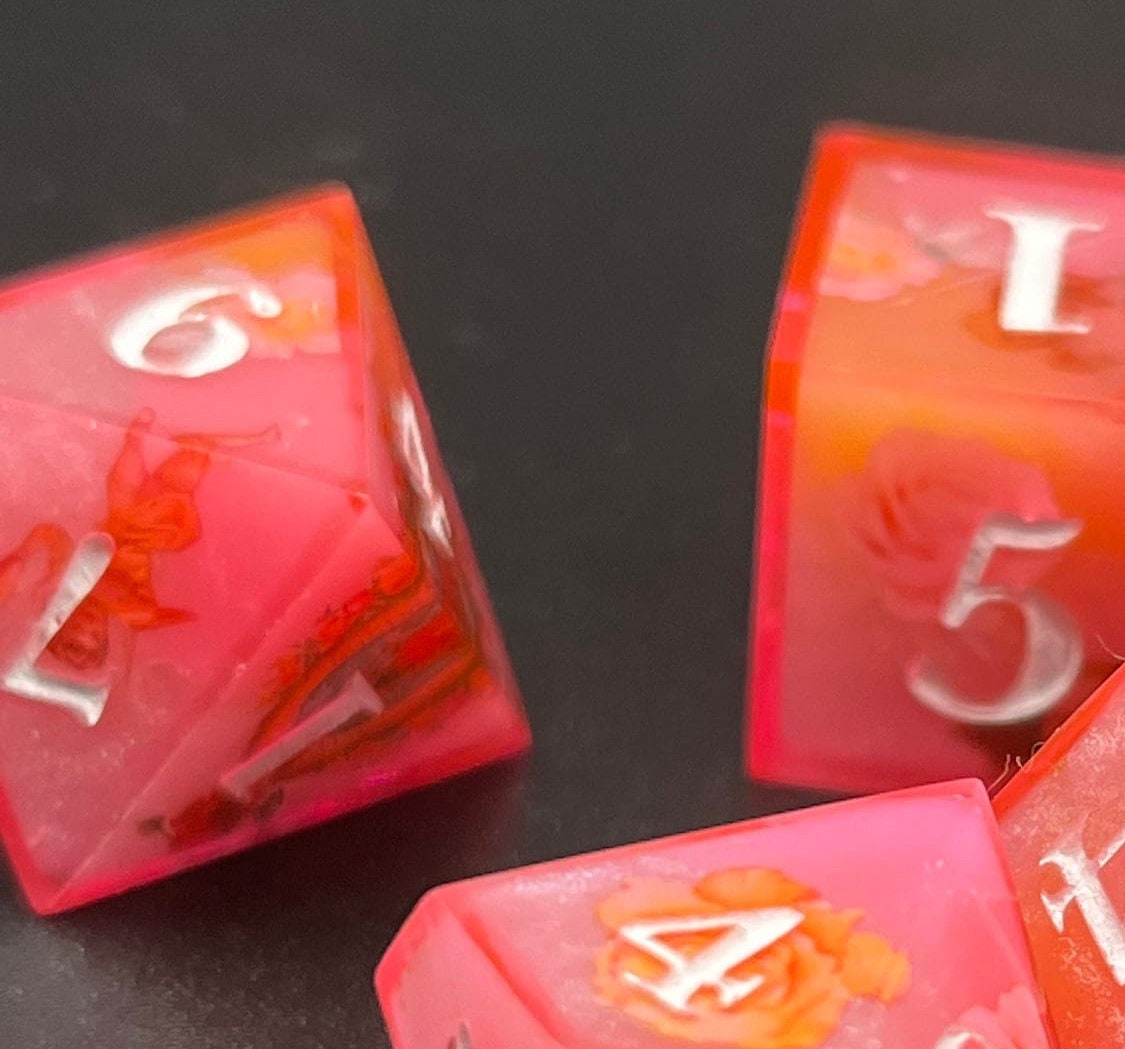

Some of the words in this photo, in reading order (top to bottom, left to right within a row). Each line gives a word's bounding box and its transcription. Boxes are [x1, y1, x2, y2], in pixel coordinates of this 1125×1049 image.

[984, 202, 1107, 334] 1
[906, 511, 1085, 725] 5
[619, 906, 806, 1013] 4
